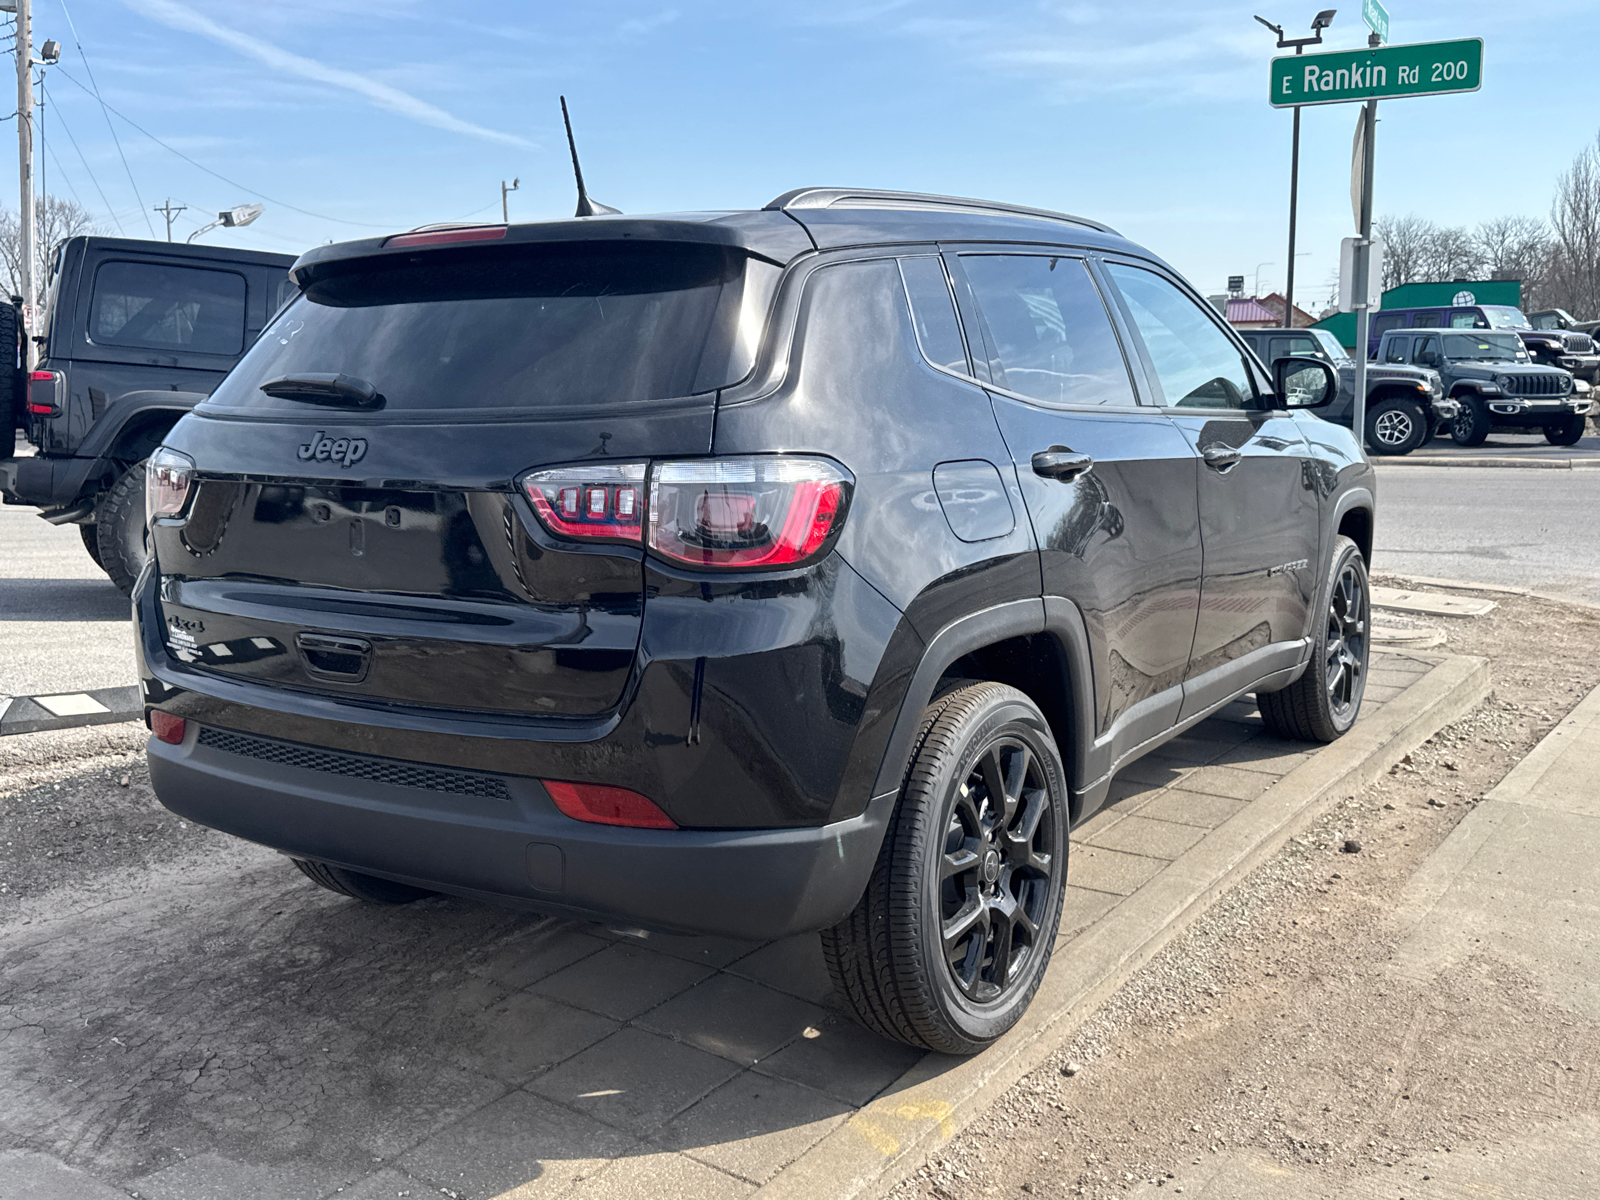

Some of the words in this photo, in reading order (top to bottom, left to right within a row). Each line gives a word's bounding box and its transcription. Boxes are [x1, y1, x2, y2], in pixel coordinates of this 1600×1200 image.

[1282, 75, 1293, 94] E
[1303, 60, 1387, 93] Rankin
[1398, 65, 1419, 85] Rd
[1431, 60, 1468, 83] 200
[297, 430, 368, 468] Jeep
